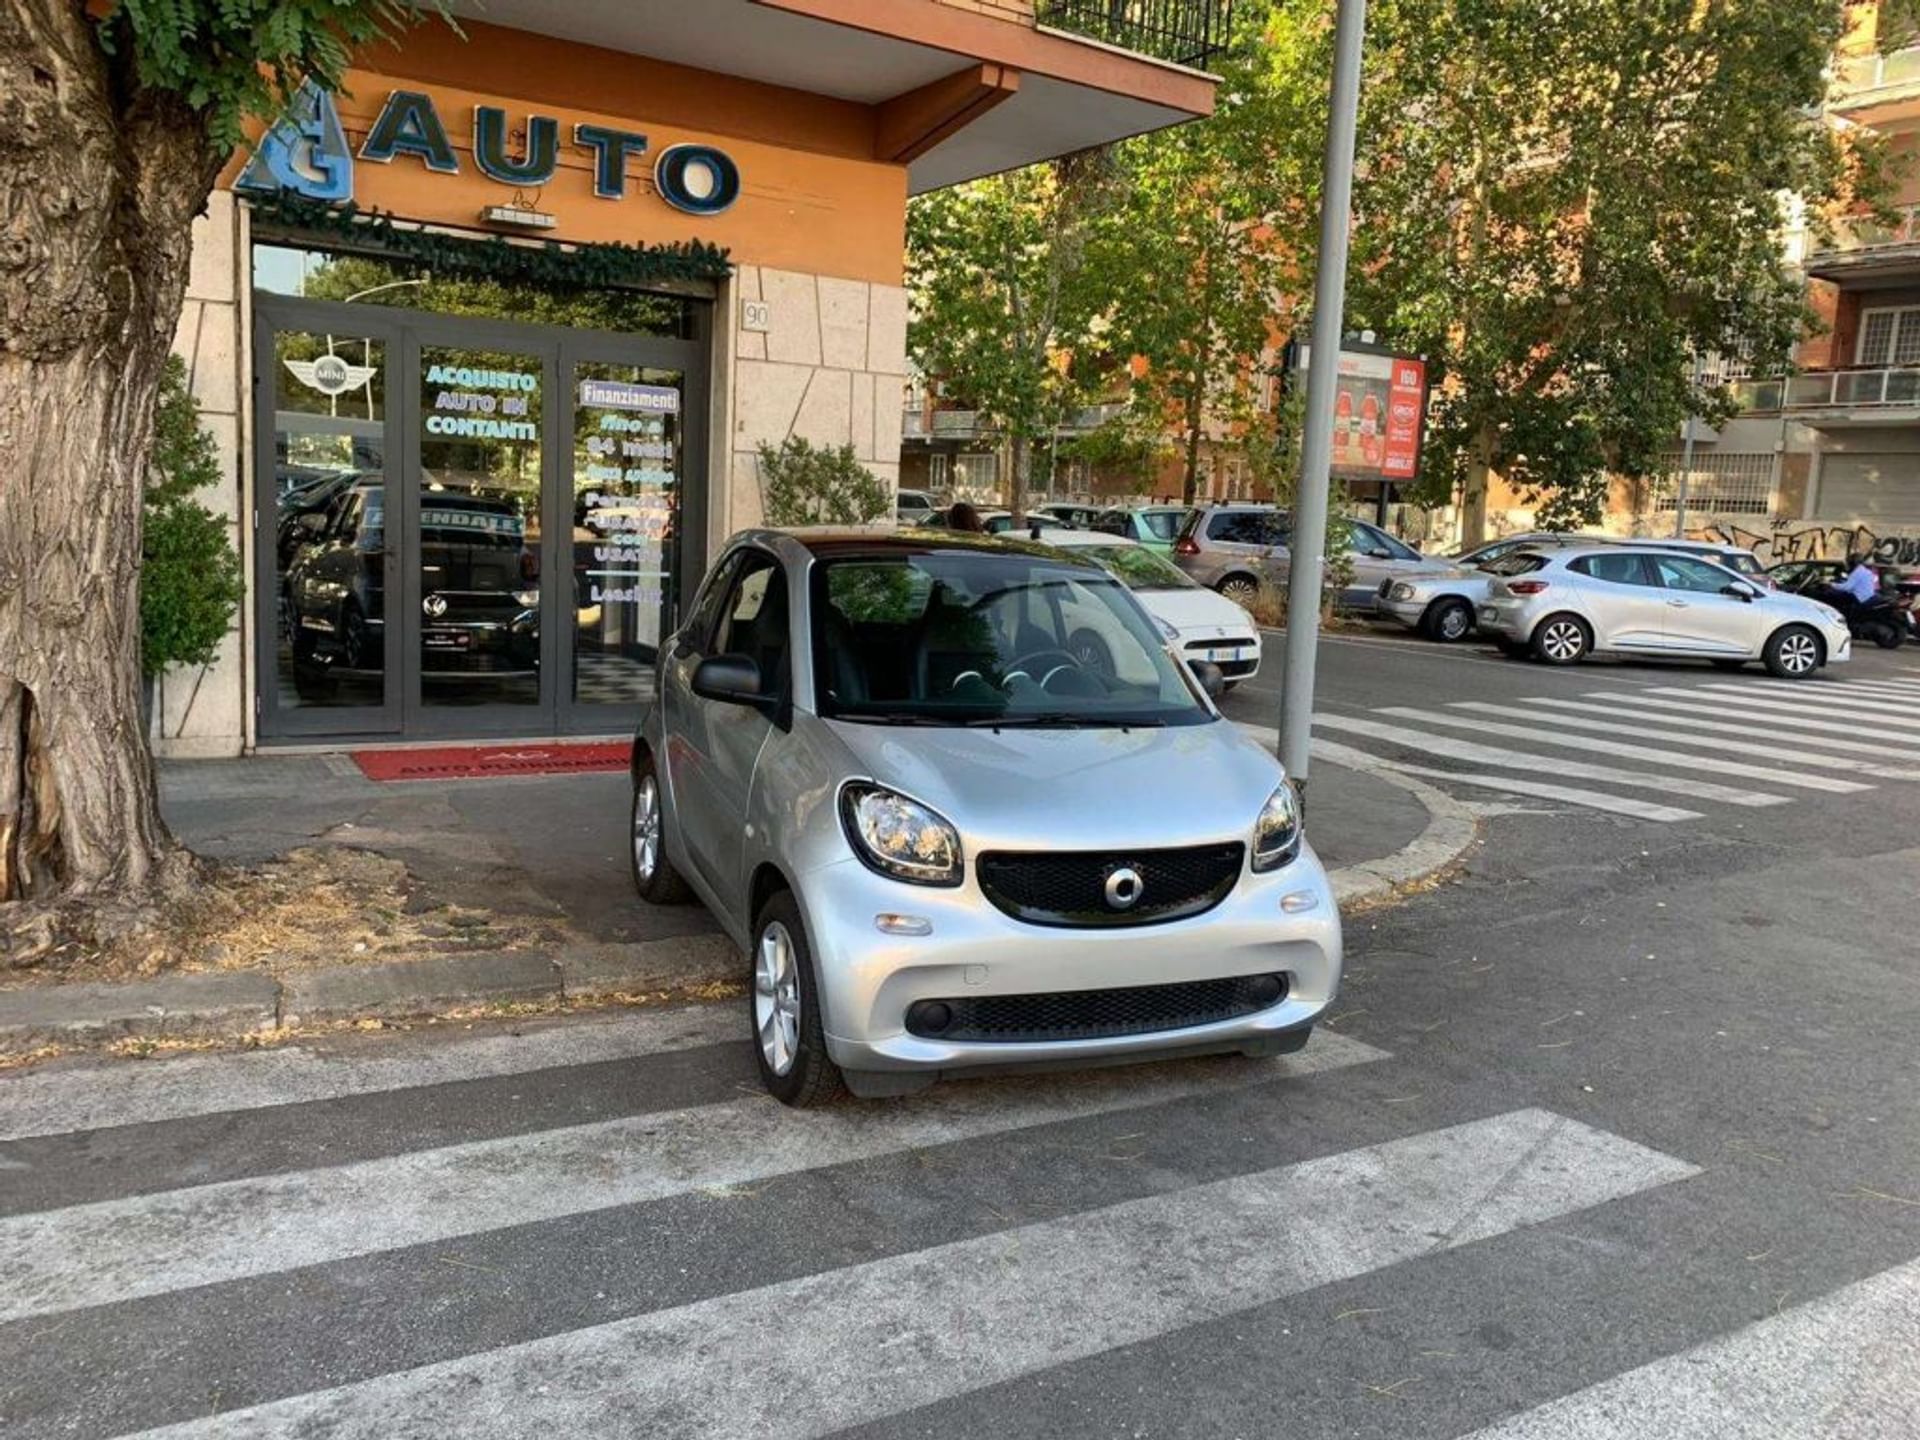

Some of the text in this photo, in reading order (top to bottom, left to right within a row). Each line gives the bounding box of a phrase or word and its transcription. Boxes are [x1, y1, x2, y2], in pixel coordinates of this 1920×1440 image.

[357, 88, 741, 216] AUTO
[746, 304, 769, 326] 90
[317, 369, 346, 381] MINI
[425, 365, 537, 391] ACQUISTO
[435, 391, 528, 415] AUTO IN
[584, 384, 677, 409] Finanziamenti
[426, 416, 536, 440] CONTANTI
[600, 414, 661, 433] fino a
